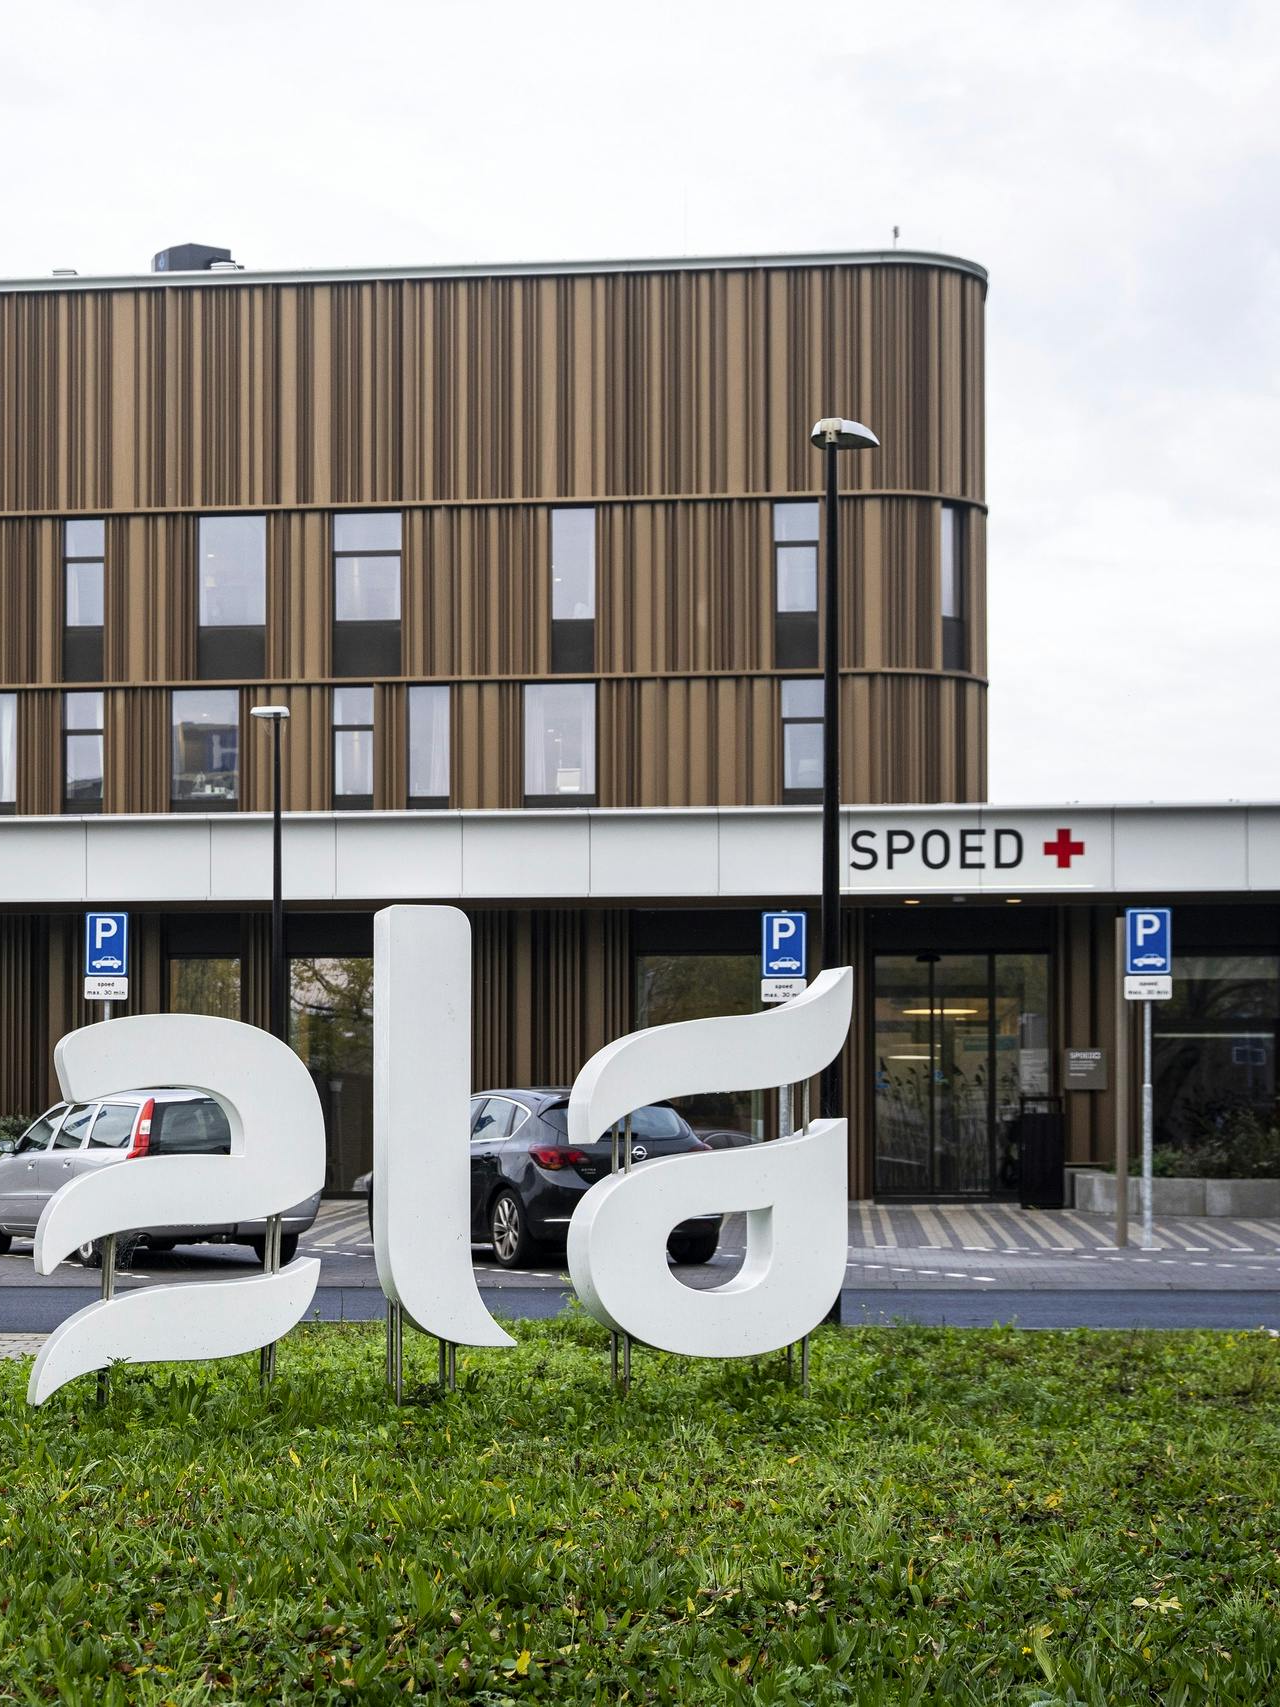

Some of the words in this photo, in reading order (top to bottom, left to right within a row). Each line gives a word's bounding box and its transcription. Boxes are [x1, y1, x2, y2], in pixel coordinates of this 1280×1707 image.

[849, 829, 1024, 870] SPOED
[95, 917, 118, 949] P
[772, 917, 796, 950] P
[1136, 913, 1161, 946] P
